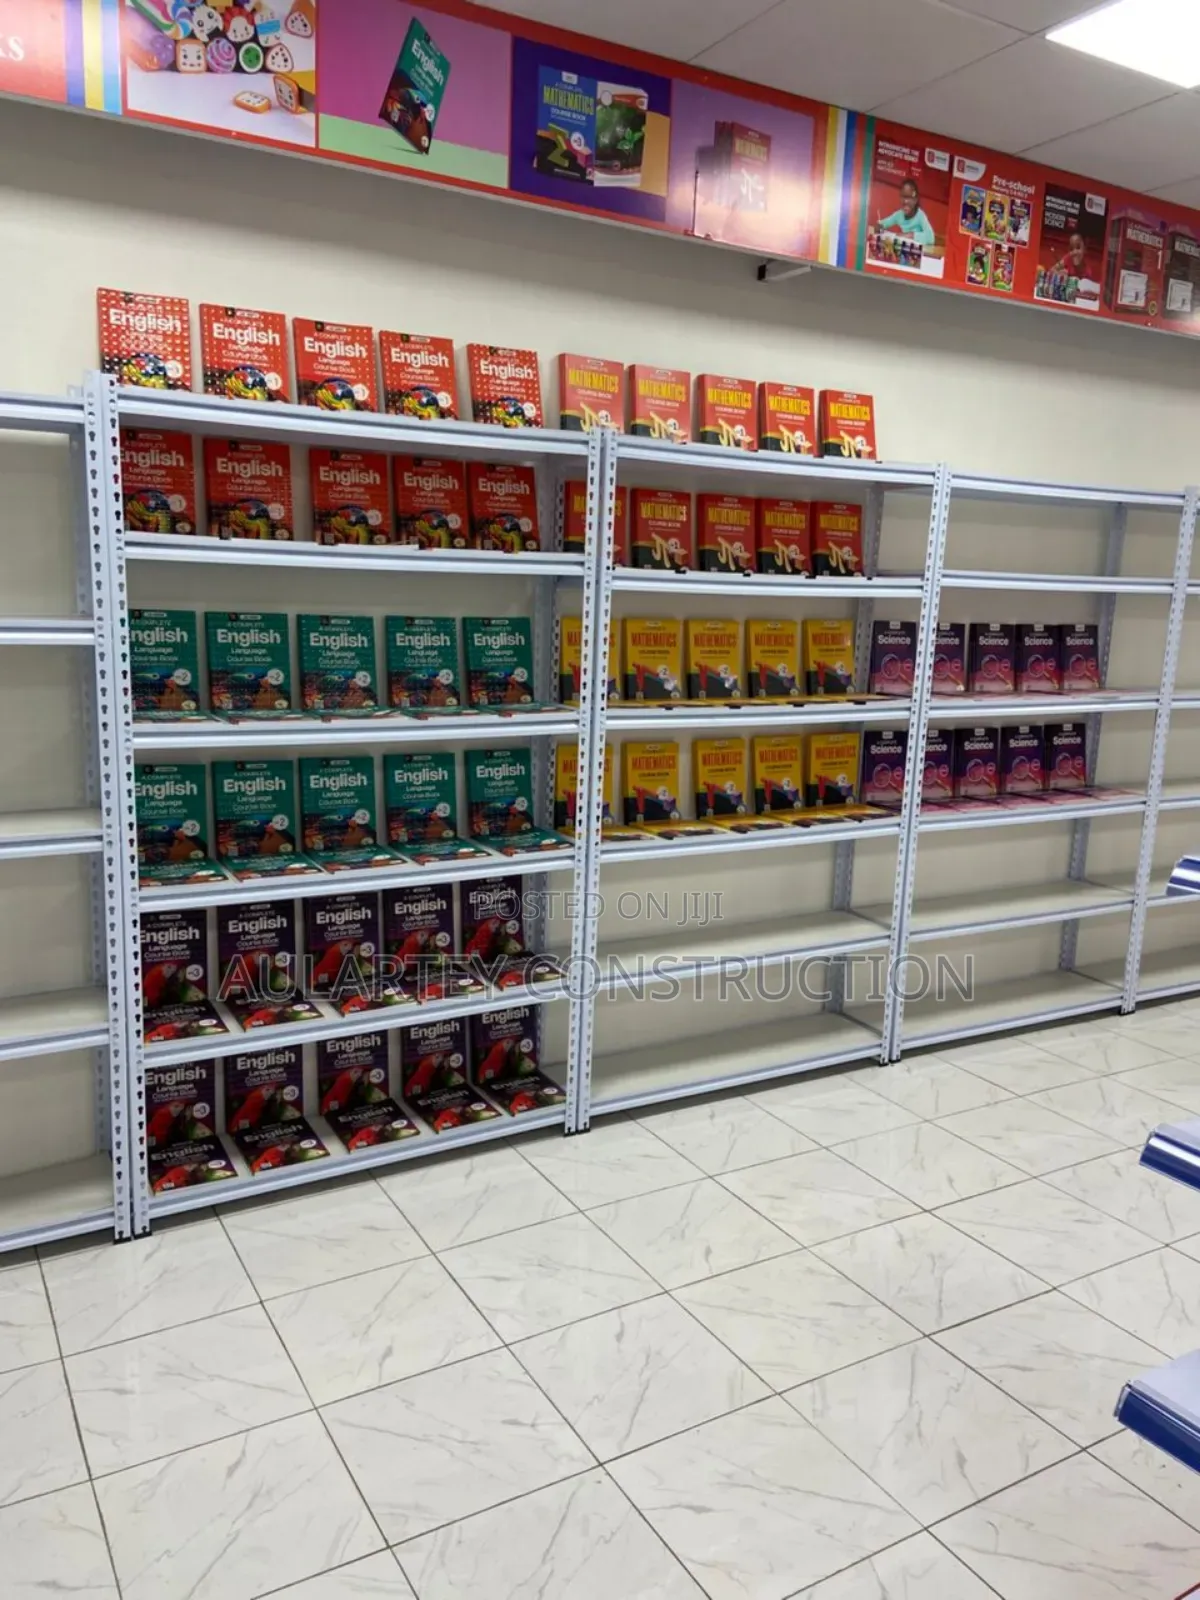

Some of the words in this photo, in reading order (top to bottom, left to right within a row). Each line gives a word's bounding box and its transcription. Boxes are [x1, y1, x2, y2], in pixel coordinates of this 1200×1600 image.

[411, 38, 444, 86] English
[992, 175, 1035, 195] Pre-school
[109, 309, 181, 335] English
[213, 323, 280, 346] English
[304, 337, 366, 359] English
[391, 349, 449, 368] English
[480, 361, 533, 380] English
[569, 368, 619, 393] MATHEMATICS
[639, 379, 686, 402] MATHEMATICS
[708, 388, 751, 408] MATHEMATICS
[769, 396, 810, 415] MATHEMATICS
[830, 402, 870, 420] MATHEMATICS
[216, 457, 282, 477] English
[319, 466, 381, 485] English
[404, 472, 459, 490] English
[478, 478, 530, 496] English
[641, 502, 686, 522] MATHEMATICS
[129, 627, 188, 645] nglish
[217, 629, 281, 646] English
[310, 633, 368, 649] English
[396, 633, 450, 649] English
[474, 634, 525, 649] English
[878, 635, 910, 645] Science
[979, 637, 1009, 646] Science
[1025, 637, 1053, 646] Science
[1066, 637, 1094, 646] Science
[871, 745, 902, 754] Science
[964, 741, 994, 750] Science
[1009, 739, 1038, 748] Science
[1053, 736, 1081, 746] Science
[476, 763, 525, 780] English
[632, 756, 676, 769] MATHEMATICS
[223, 777, 286, 795] English
[310, 772, 367, 791] English
[395, 768, 448, 786] English
[470, 888, 516, 905] English
[394, 898, 447, 916] English
[228, 915, 287, 934] English
[316, 907, 371, 926] English
[482, 1006, 529, 1024] English
[411, 1021, 460, 1039] English
[327, 1035, 381, 1053] English
[237, 1052, 295, 1070] English
[145, 1067, 206, 1085] English
[492, 1076, 540, 1090] English
[418, 1089, 469, 1106] English
[338, 1107, 393, 1122] English
[243, 1125, 303, 1142] English
[151, 1144, 214, 1161] English
